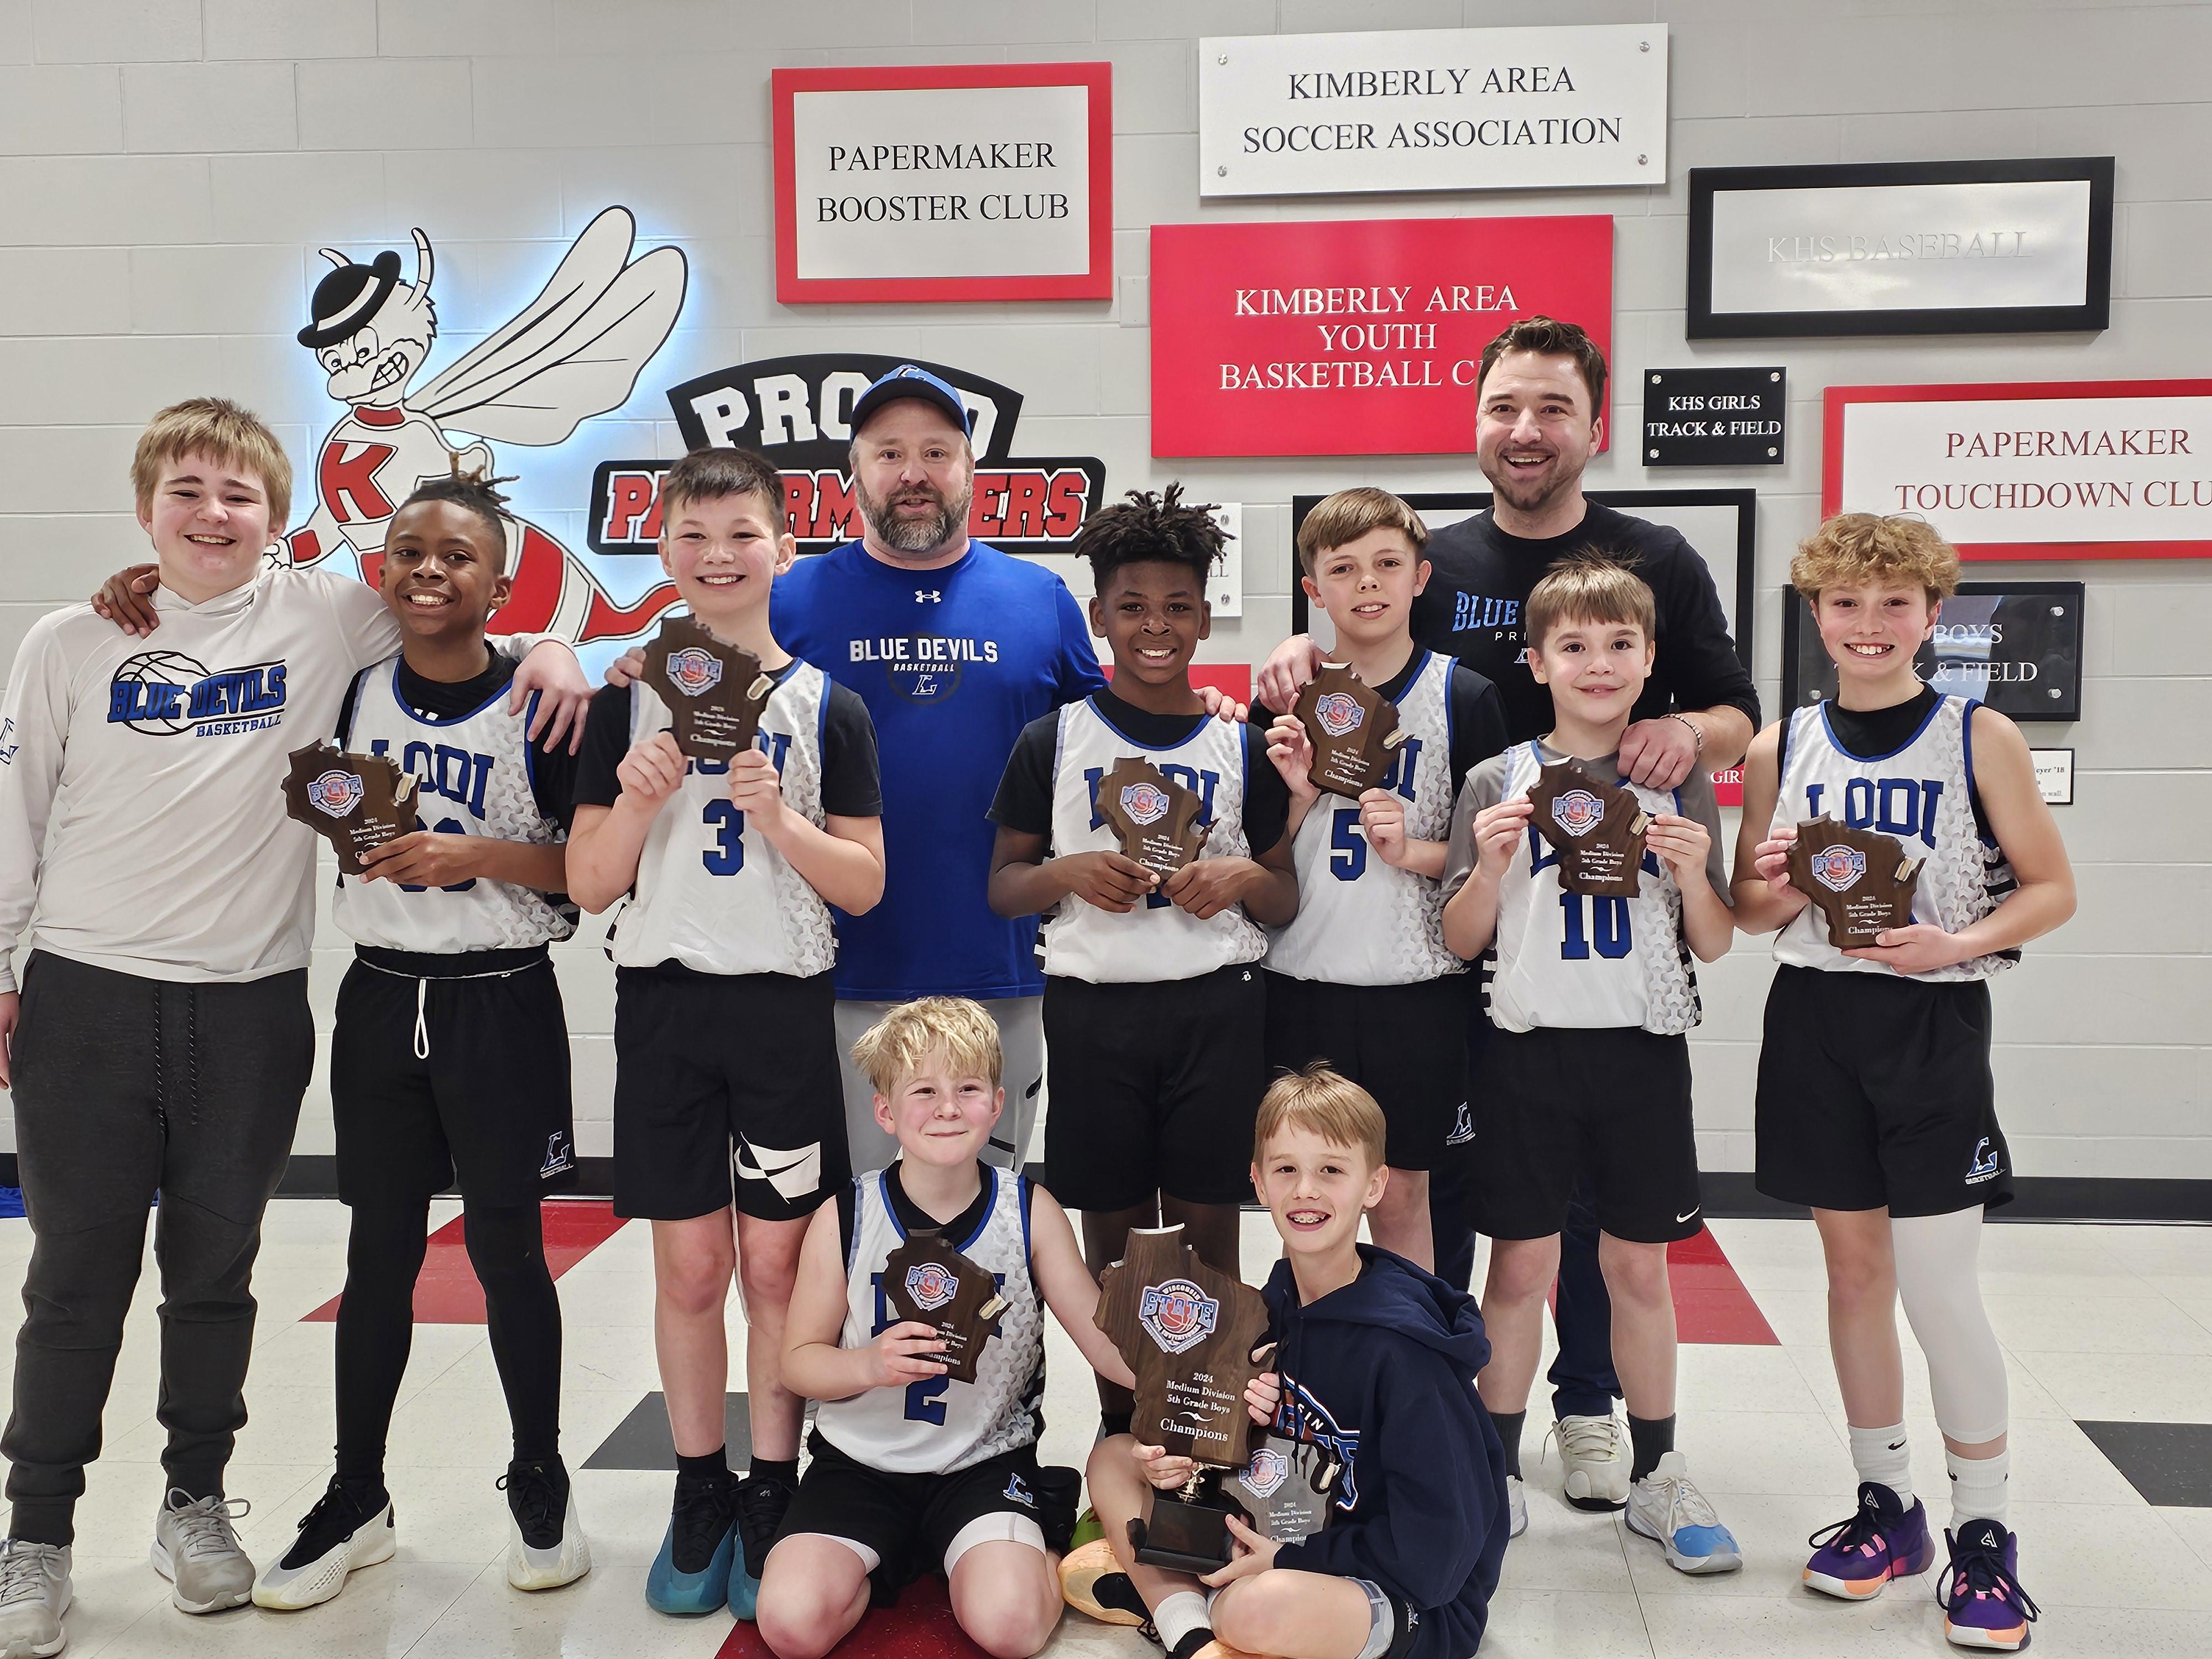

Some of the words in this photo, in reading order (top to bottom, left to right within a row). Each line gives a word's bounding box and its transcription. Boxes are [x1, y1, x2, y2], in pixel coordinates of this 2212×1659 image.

[1288, 69, 1471, 100] KIMBERLY
[1480, 66, 1576, 94] AREA
[1244, 123, 1379, 154] SOCCER
[1387, 117, 1623, 149] ASSOCIATION
[828, 143, 1057, 171] PAPERMAKER
[816, 195, 972, 222] BOOSTER
[979, 194, 1070, 220] CLUB
[1768, 236, 1835, 263] KHS
[1846, 231, 2036, 262] BASEBALL
[1234, 285, 1412, 316] KIMBERLY
[1425, 285, 1520, 312] AREA
[1317, 323, 1437, 352] YOUTH
[1219, 361, 1443, 389] BASKETBALL
[1668, 395, 1704, 411] KHS
[1708, 395, 1761, 410] GIRLS
[690, 372, 998, 463] PROD
[1647, 421, 1708, 436] TRACK
[1712, 421, 1726, 436] &
[1730, 421, 1782, 435] FIELD
[1945, 429, 2192, 458] PAPERMAKER
[1894, 482, 2134, 510] TOUCHDOWN
[1452, 591, 1519, 632] BLUE
[1931, 623, 2003, 644] BOYS
[850, 638, 910, 661] BLUE
[917, 638, 998, 662] DEVILS
[893, 664, 954, 672] BASKETBALL
[1935, 662, 1954, 682] &
[1960, 662, 2038, 682] FIELD
[107, 681, 186, 723] BLUE
[187, 664, 287, 719] DEVILS
[196, 714, 281, 737] BASKETBALL
[1710, 770, 1744, 784] GIR
[1084, 764, 1220, 832] LDI
[702, 798, 744, 876] 3
[1330, 808, 1368, 881] 5
[1139, 858, 1179, 872] Champions
[1579, 872, 1623, 883] Champions
[1559, 893, 1633, 960] 10
[1848, 925, 1893, 935] Champio
[1144, 1292, 1215, 1328] STATE
[924, 1352, 961, 1365] ampions
[1166, 1380, 1199, 1394] Medium
[1202, 1386, 1235, 1401] Division
[1193, 1372, 1213, 1383] 2024
[1167, 1394, 1181, 1404] 5th
[1183, 1396, 1209, 1409] Grade
[1211, 1402, 1230, 1415] Boys
[1160, 1418, 1229, 1442] Champions
